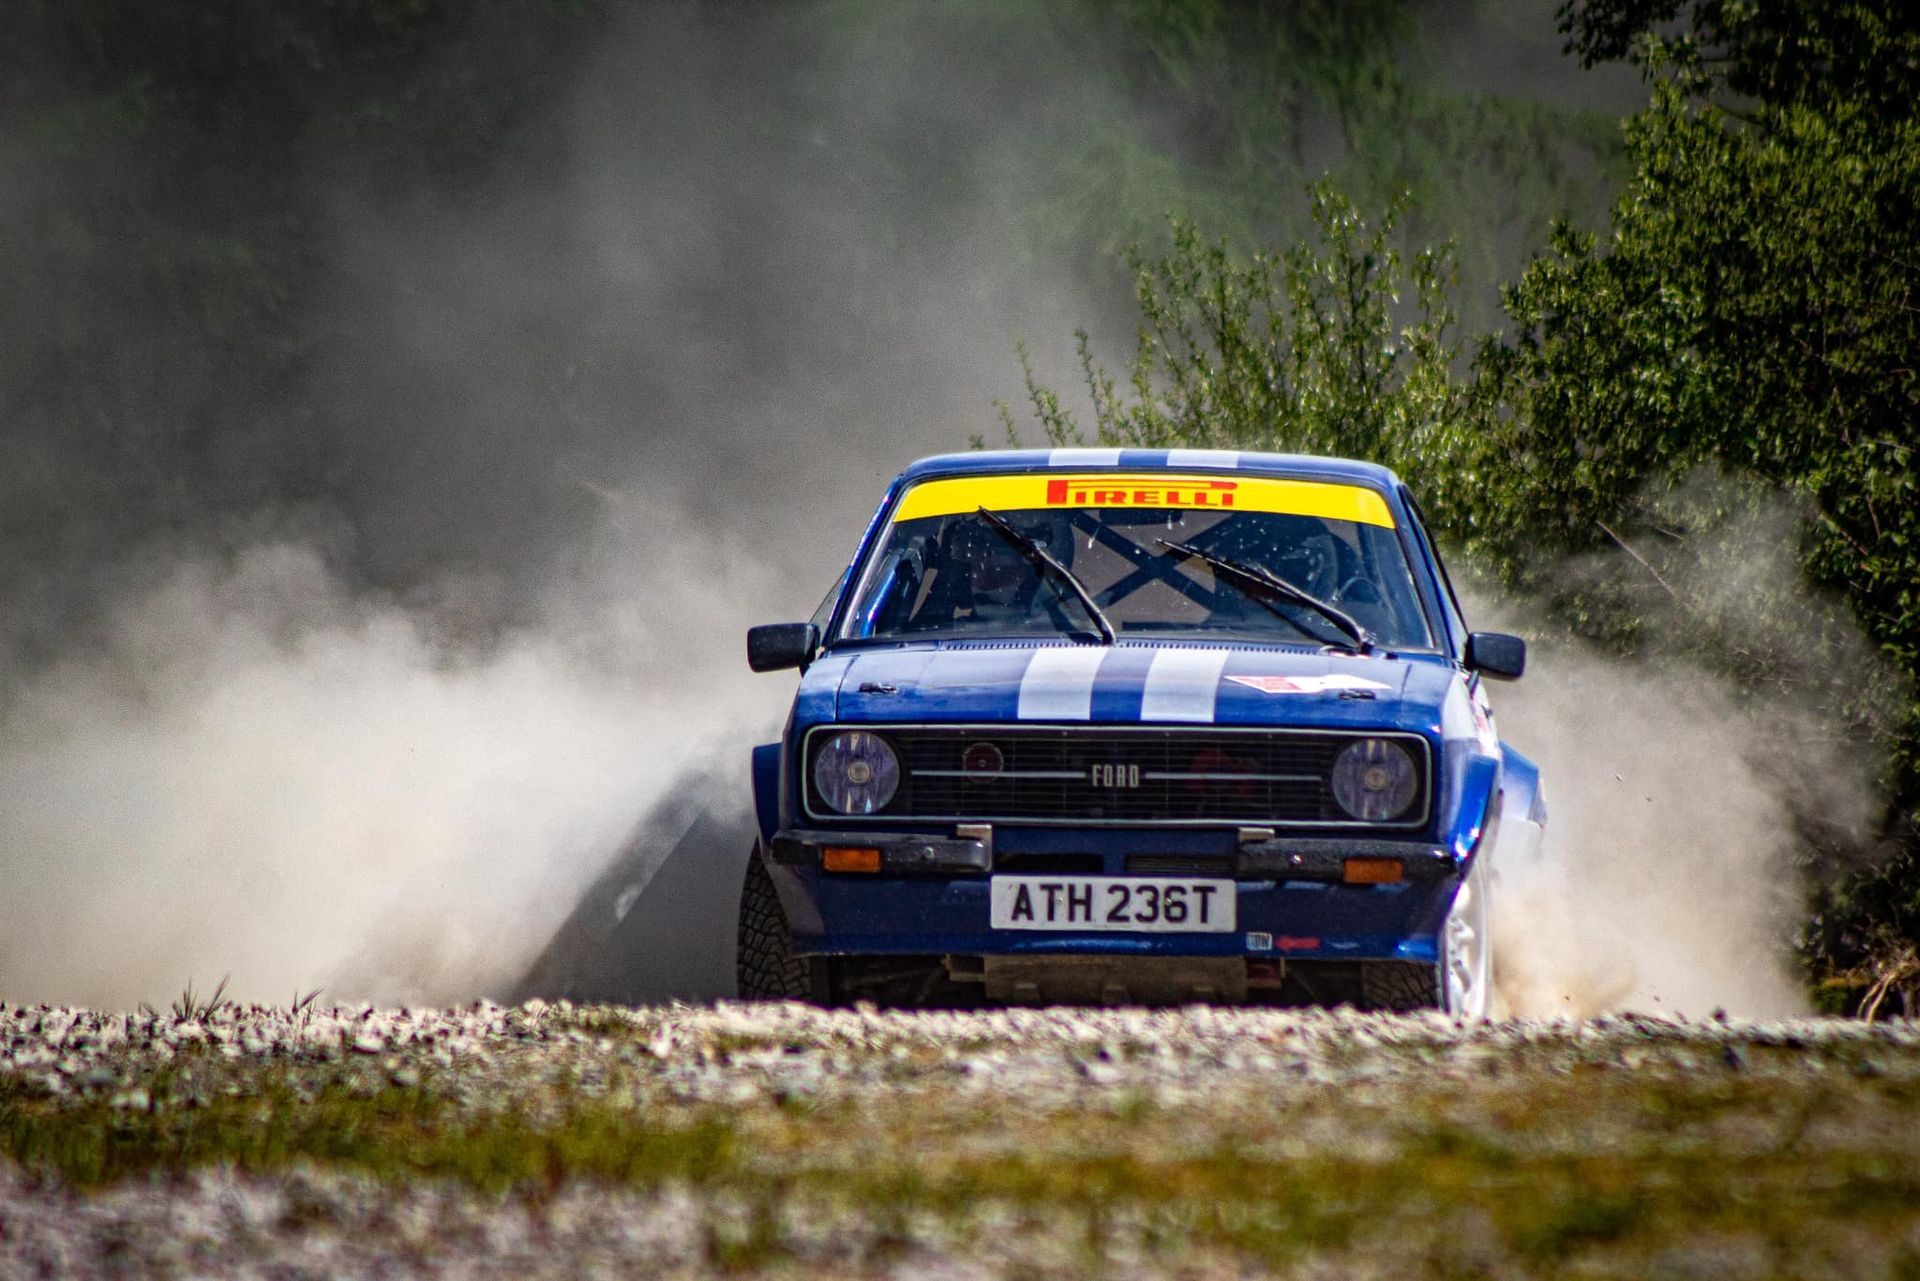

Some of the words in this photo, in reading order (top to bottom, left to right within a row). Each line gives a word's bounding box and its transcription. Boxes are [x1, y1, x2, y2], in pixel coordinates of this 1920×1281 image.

[1046, 479, 1238, 506] PIRELLI
[1092, 764, 1139, 787] FORD
[1011, 883, 1093, 922] ATH
[1106, 885, 1216, 924] 236T
